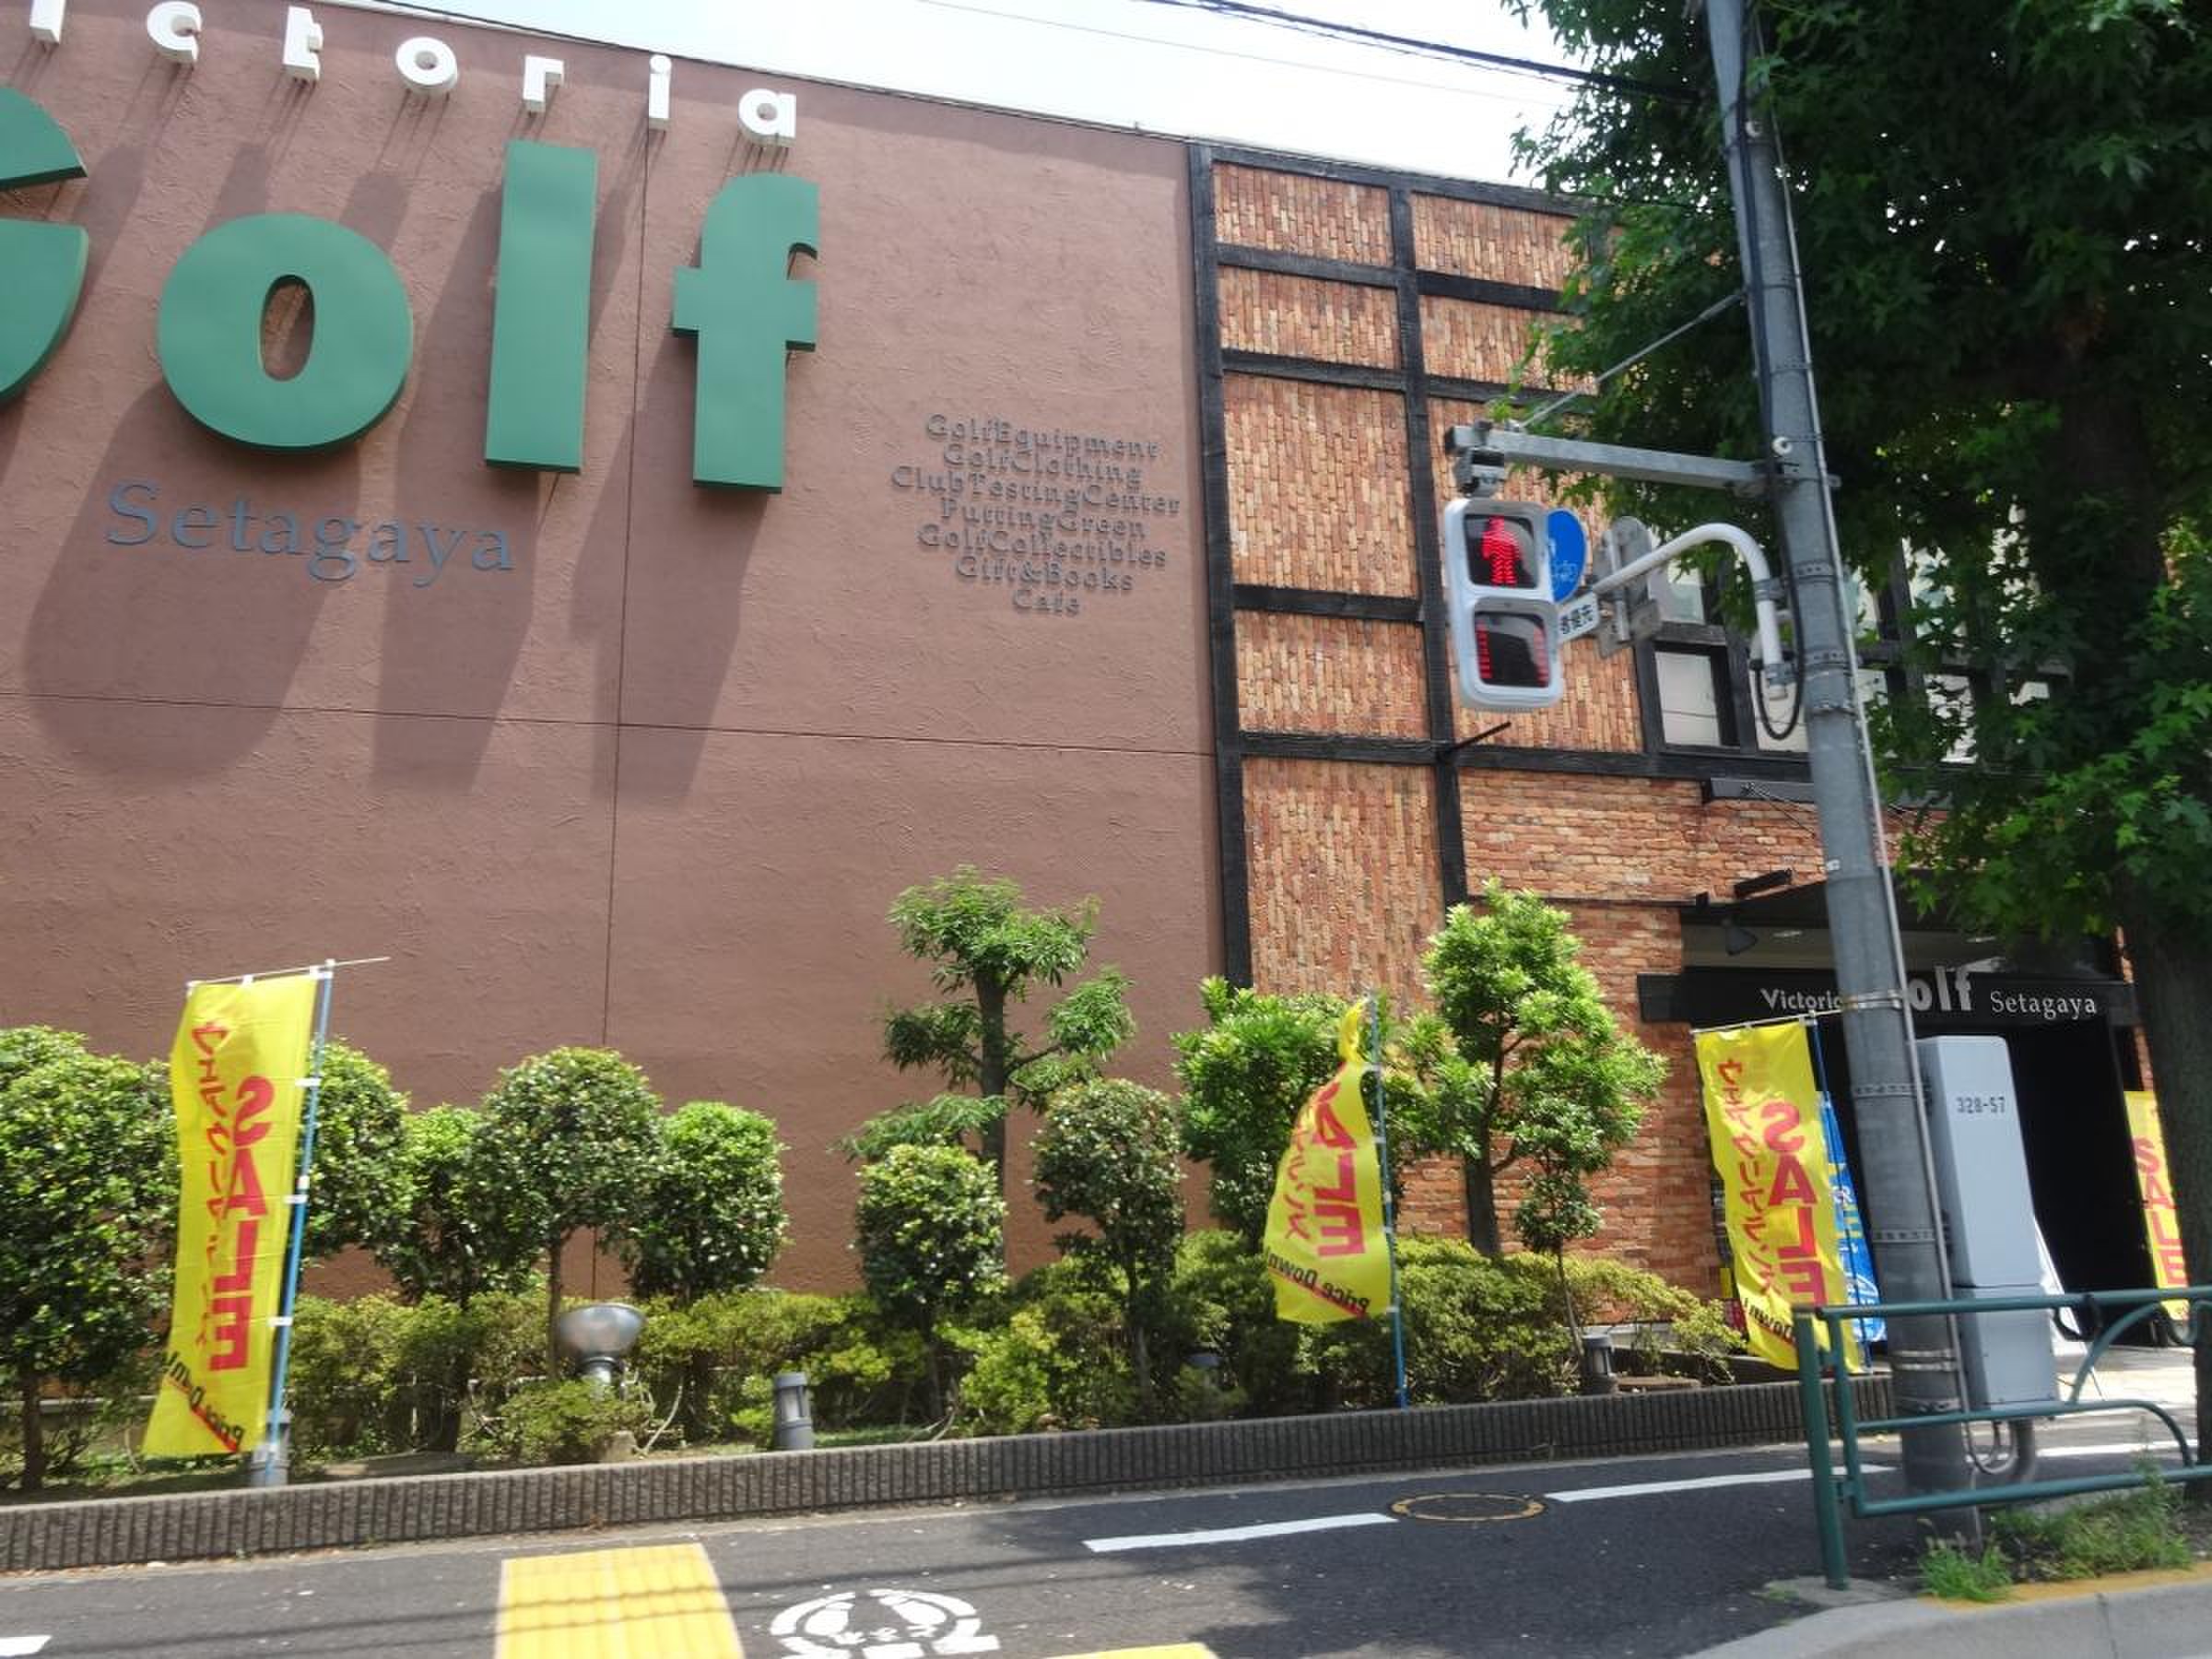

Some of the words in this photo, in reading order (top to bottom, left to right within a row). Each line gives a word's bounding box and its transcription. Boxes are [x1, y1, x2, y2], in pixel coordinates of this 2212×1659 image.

[106, 477, 515, 588] Setagaya
[1990, 991, 2097, 1019] Setagaya
[2133, 1136, 2190, 1288] SALE
